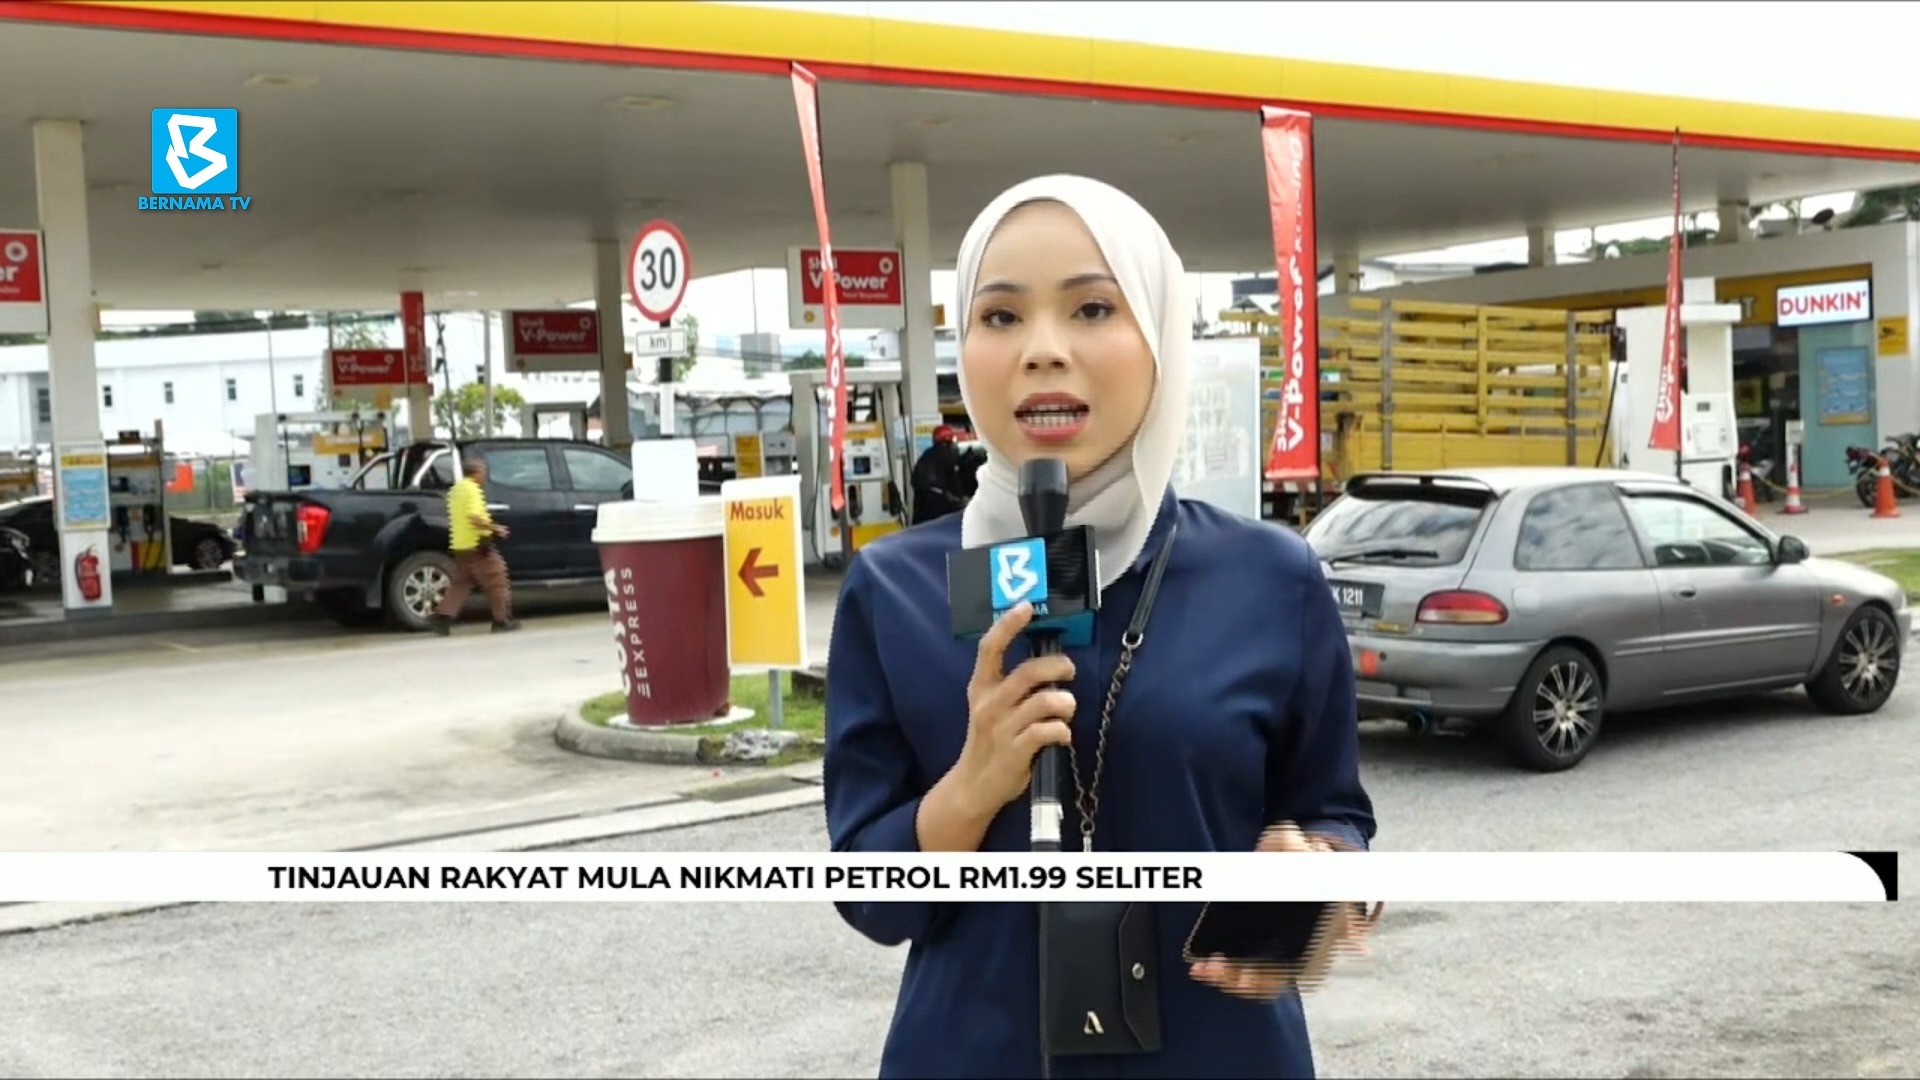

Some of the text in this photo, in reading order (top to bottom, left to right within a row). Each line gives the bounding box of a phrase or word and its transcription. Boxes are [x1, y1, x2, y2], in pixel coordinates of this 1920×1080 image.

[641, 247, 676, 291] 30
[808, 255, 838, 271] Shl
[809, 271, 888, 290] VPower
[1779, 291, 1866, 317] DUNKIN'
[730, 498, 784, 521] Masuk
[1343, 586, 1363, 606] 1211
[621, 567, 648, 679] EXPRESS
